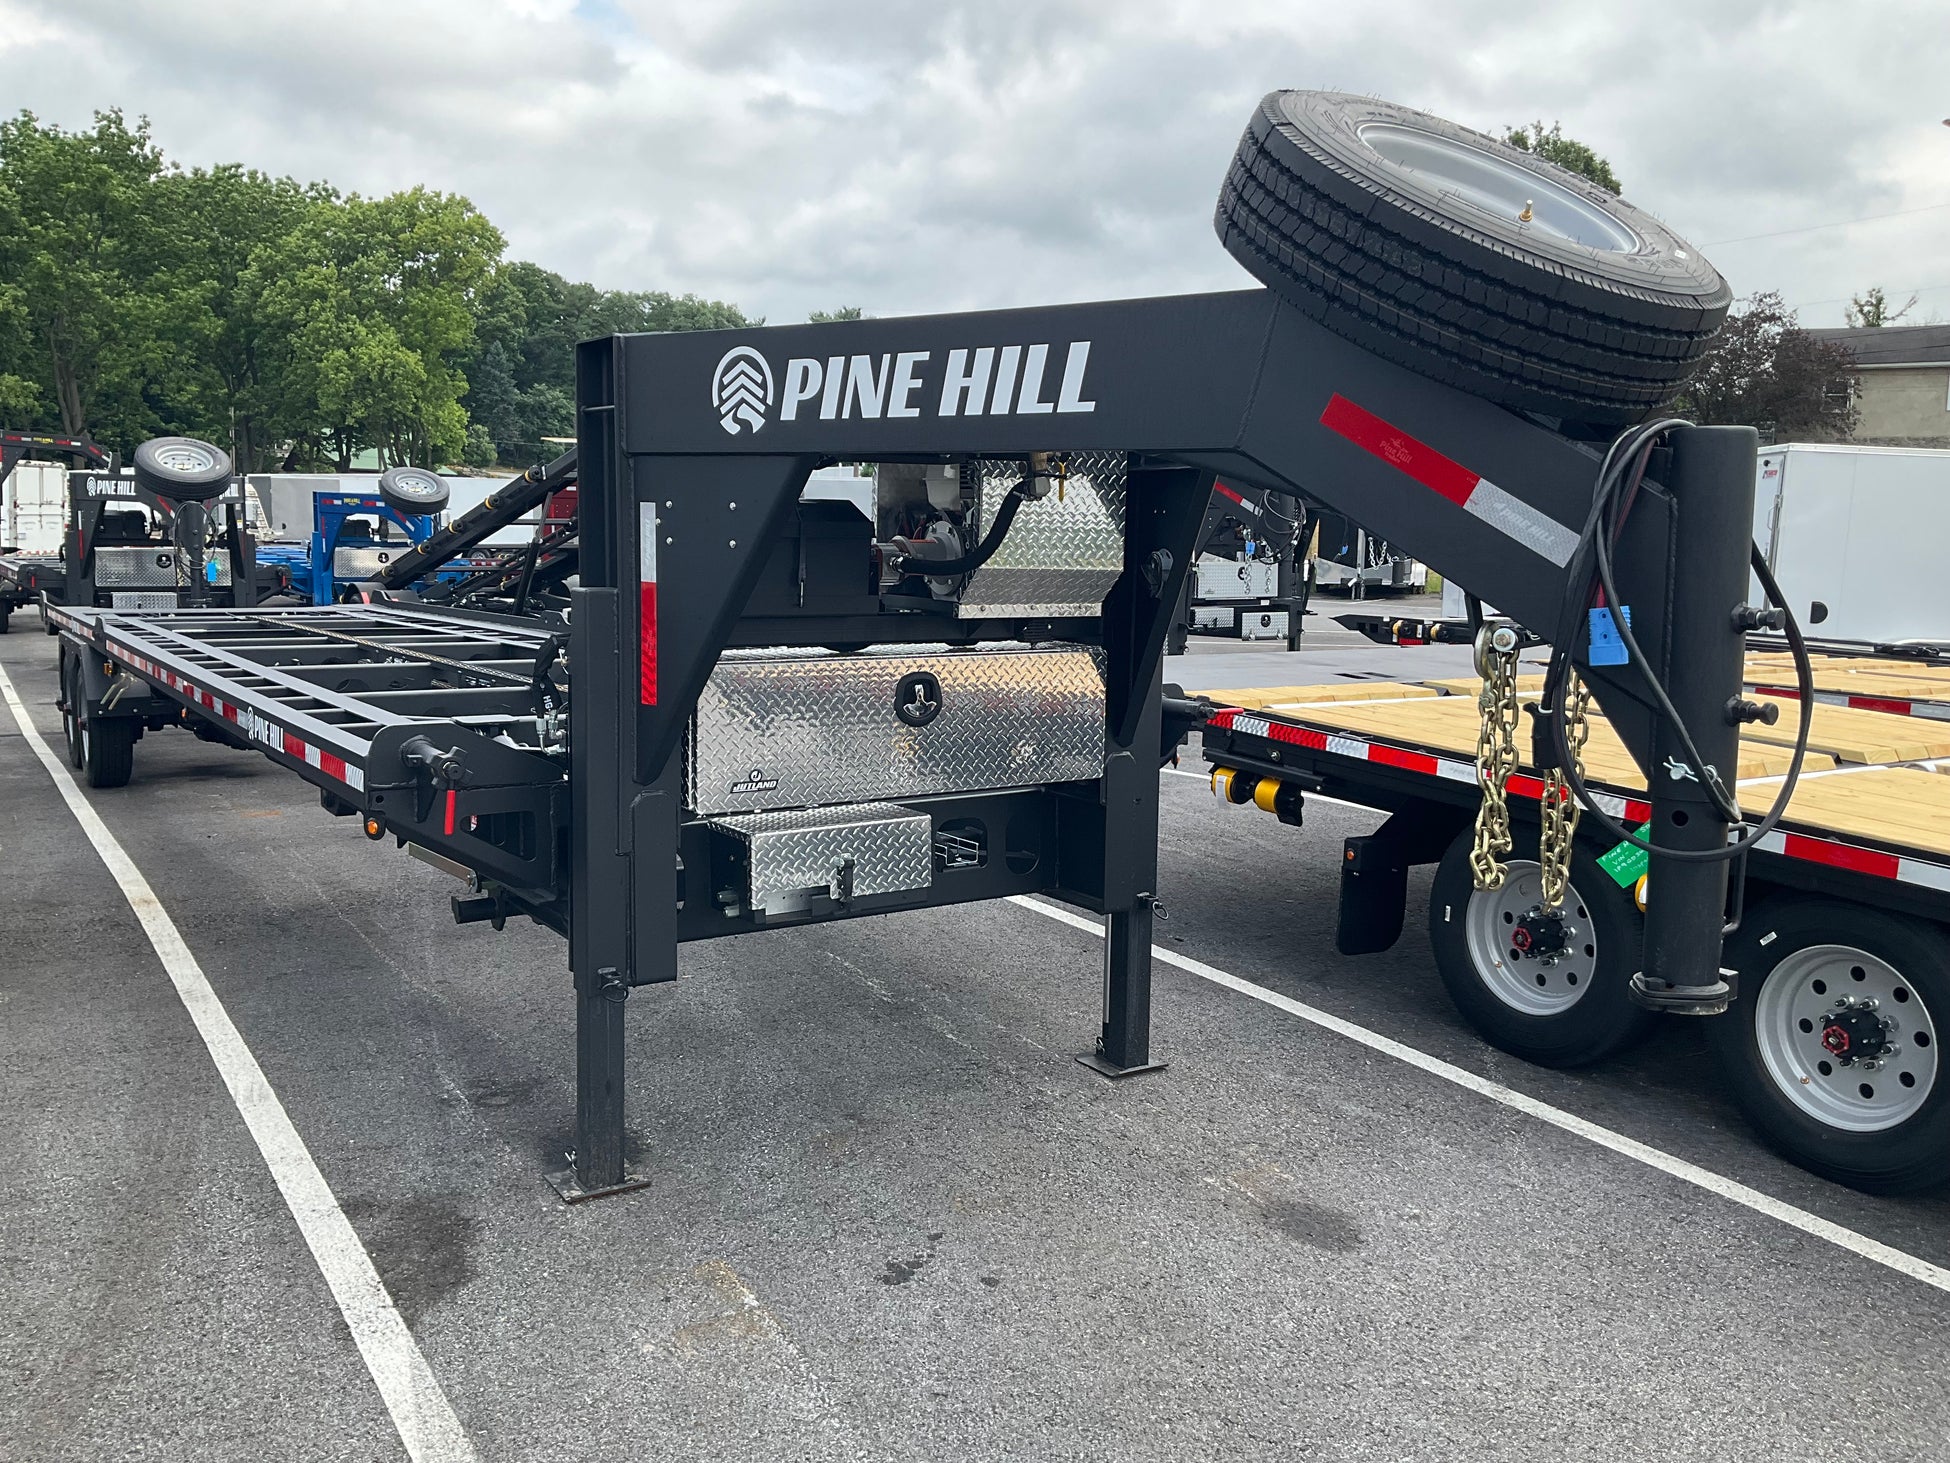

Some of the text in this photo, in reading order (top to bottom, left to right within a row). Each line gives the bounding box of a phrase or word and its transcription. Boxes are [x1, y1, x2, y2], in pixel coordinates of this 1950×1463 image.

[780, 341, 1096, 420] PINE HILL
[1379, 441, 1413, 464] Pine Hill
[96, 480, 136, 496] PINE HILL
[254, 714, 285, 754] PINE HILL
[732, 780, 777, 791] JUTLAND
